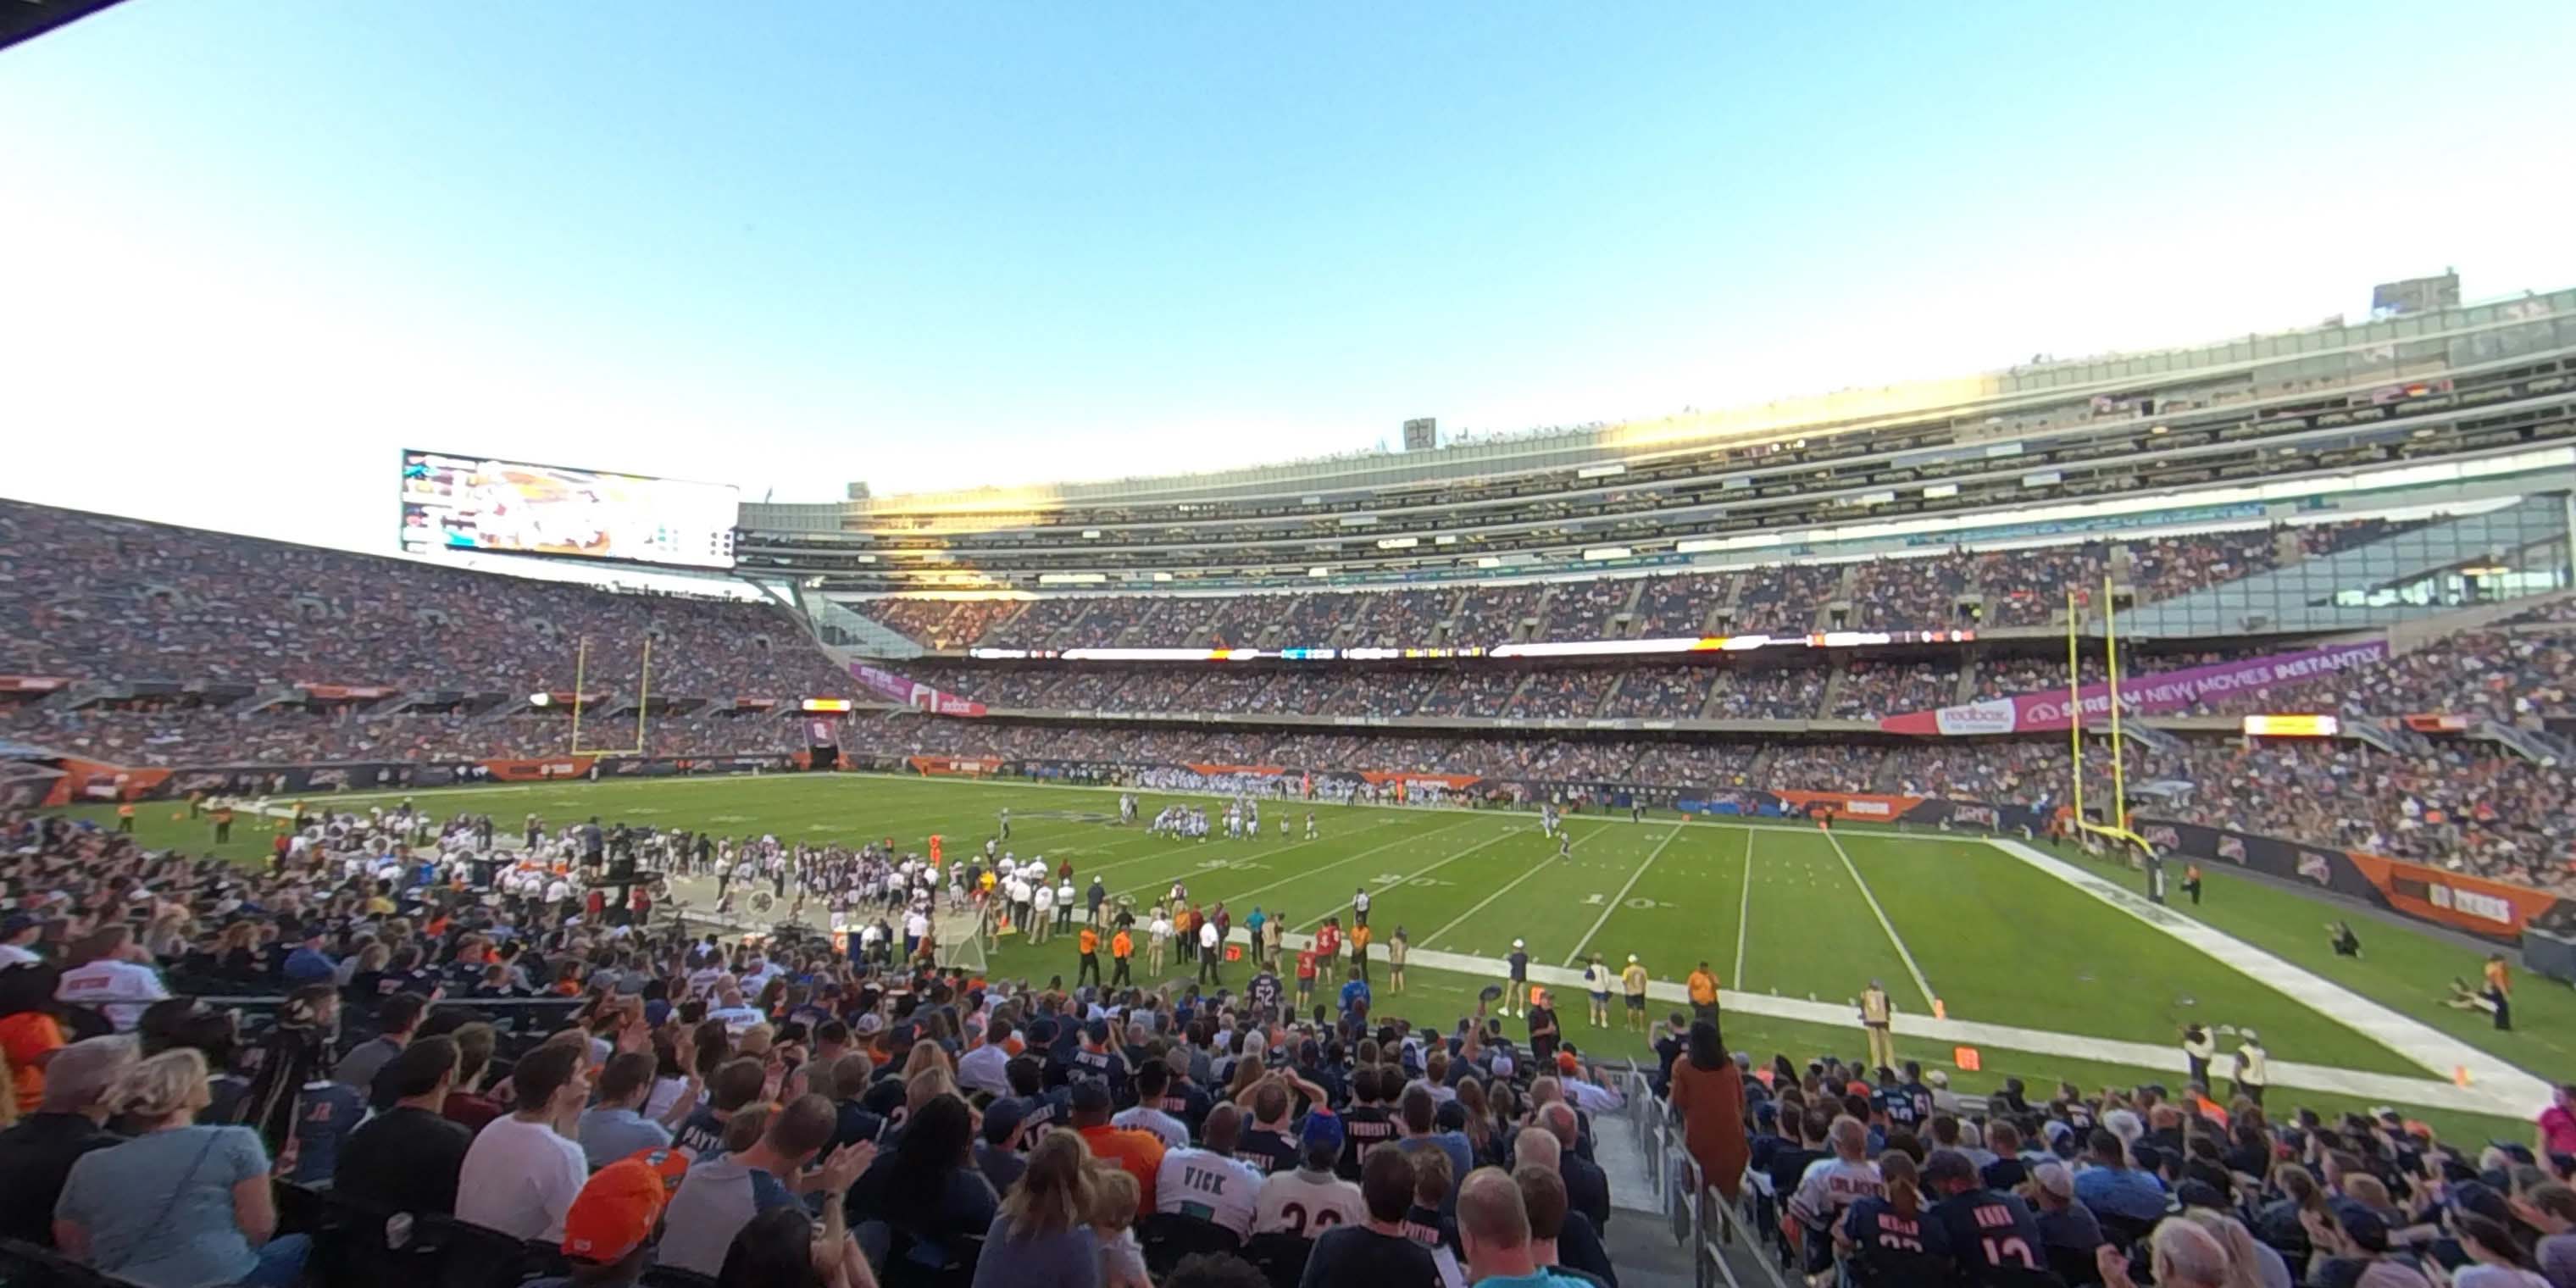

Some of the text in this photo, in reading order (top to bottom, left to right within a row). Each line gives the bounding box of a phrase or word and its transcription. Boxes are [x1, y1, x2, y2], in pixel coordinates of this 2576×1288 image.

[2061, 645, 2384, 716] STREAM NEW MOVIES INSTANTLY
[1184, 1165, 1227, 1196] VICK
